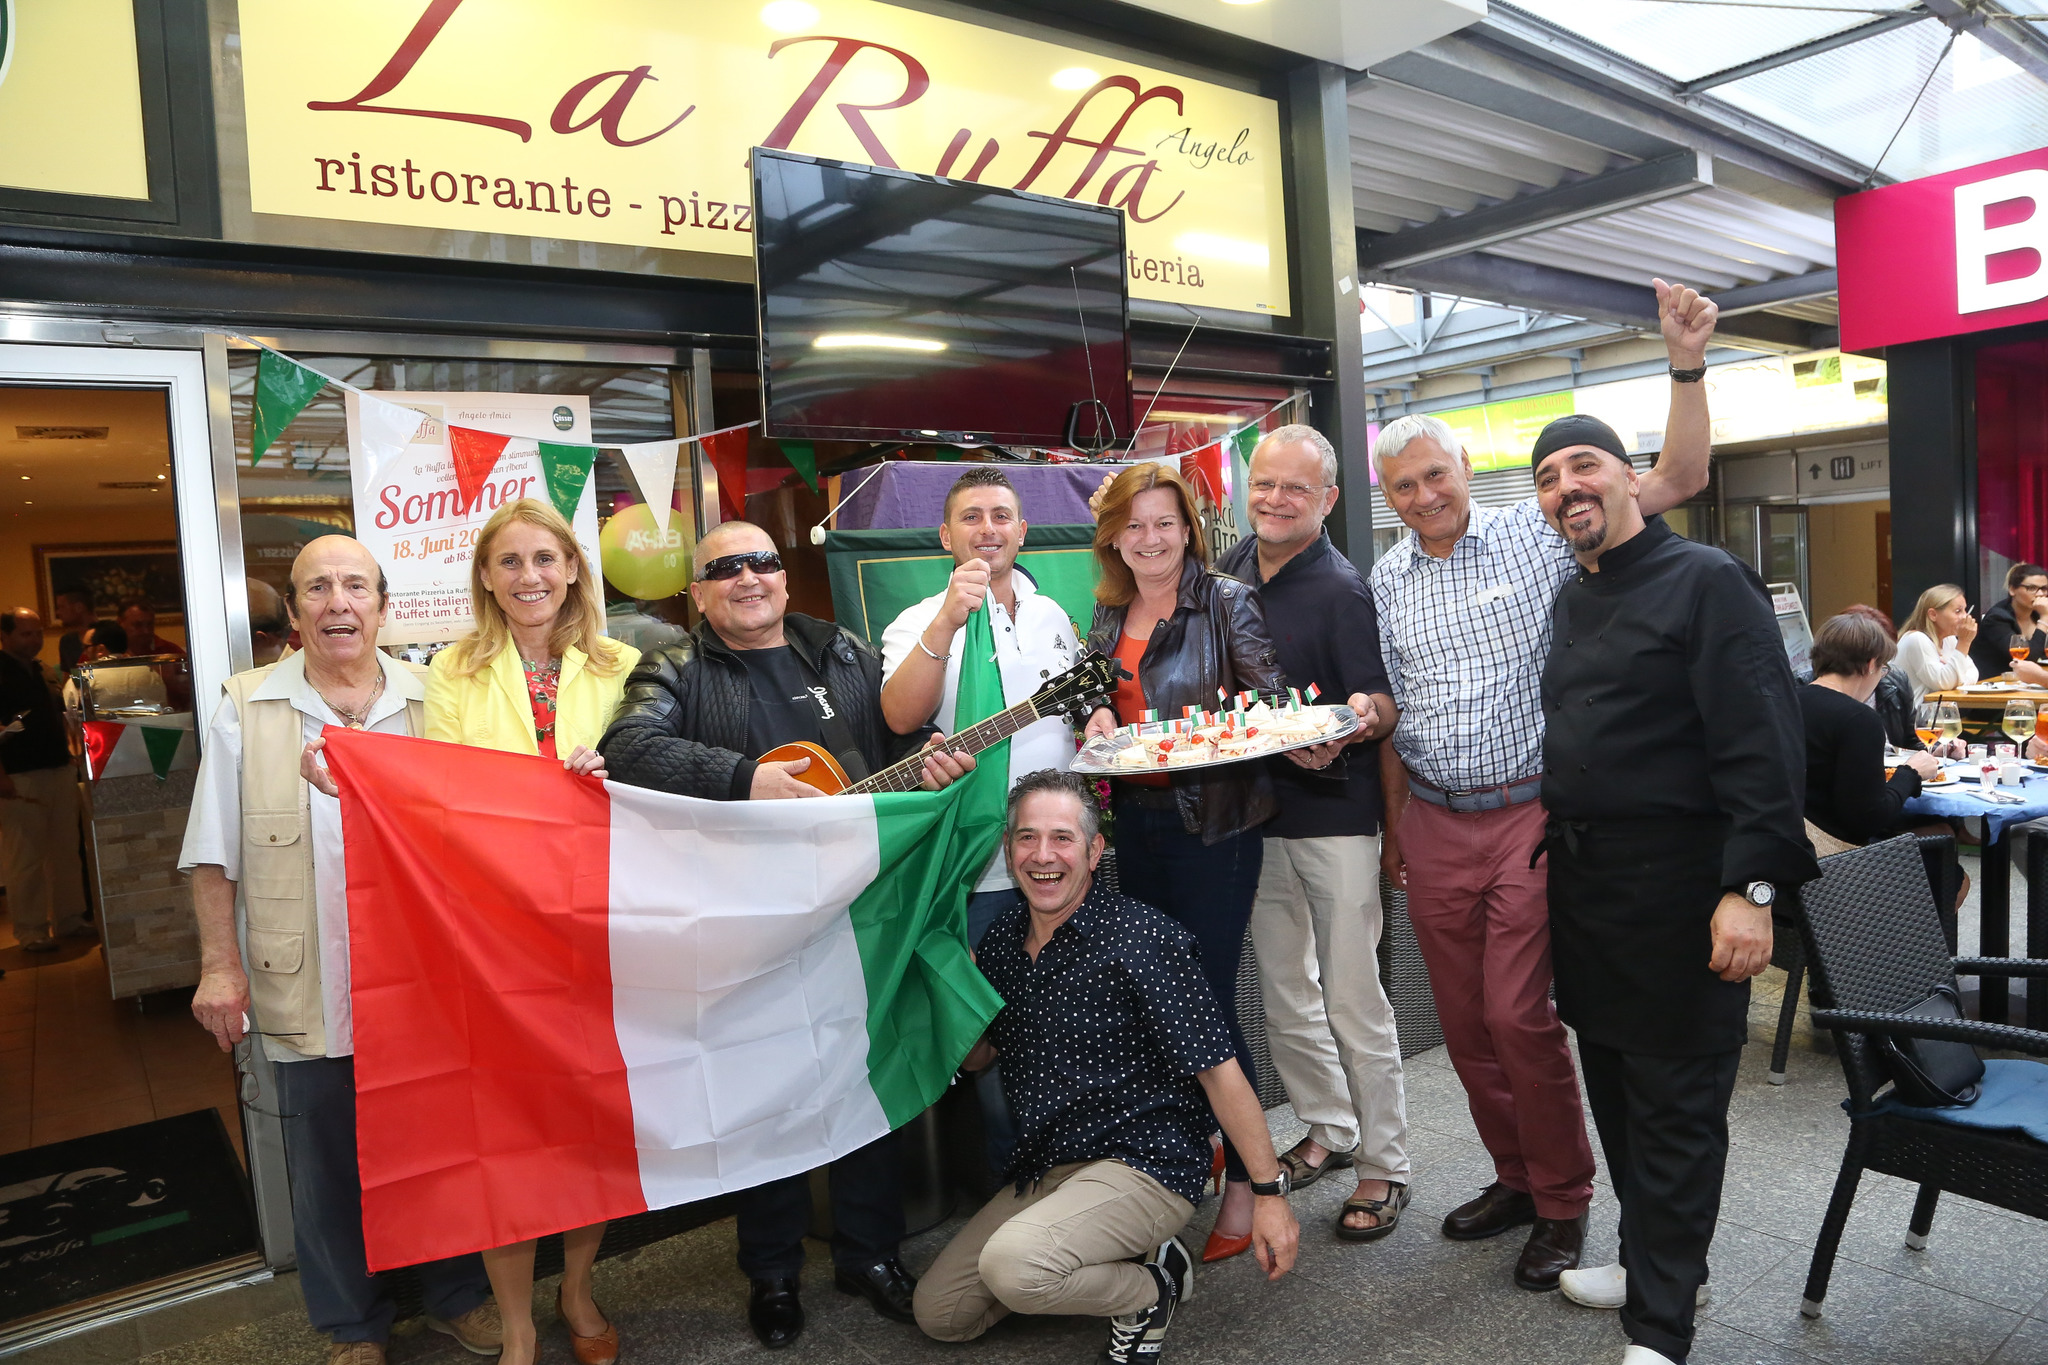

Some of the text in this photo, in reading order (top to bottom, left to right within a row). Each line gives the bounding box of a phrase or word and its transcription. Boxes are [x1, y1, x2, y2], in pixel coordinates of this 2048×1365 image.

[307, 0, 1185, 223] La Ruffa
[1156, 126, 1254, 169] Angelo
[315, 152, 612, 218] ristorante
[658, 191, 753, 235] pizz
[1953, 168, 2048, 315] B
[1128, 248, 1205, 288] teria
[416, 418, 436, 439] ffa
[458, 411, 512, 420] Angelo Amici
[1860, 459, 1883, 471] LIFT
[393, 540, 415, 560] 18.
[418, 533, 454, 560] Juni
[444, 554, 455, 564] ab
[395, 608, 430, 620] Buffet
[433, 609, 451, 618] um
[399, 598, 430, 609] tolles
[807, 686, 836, 720] Ibanez
